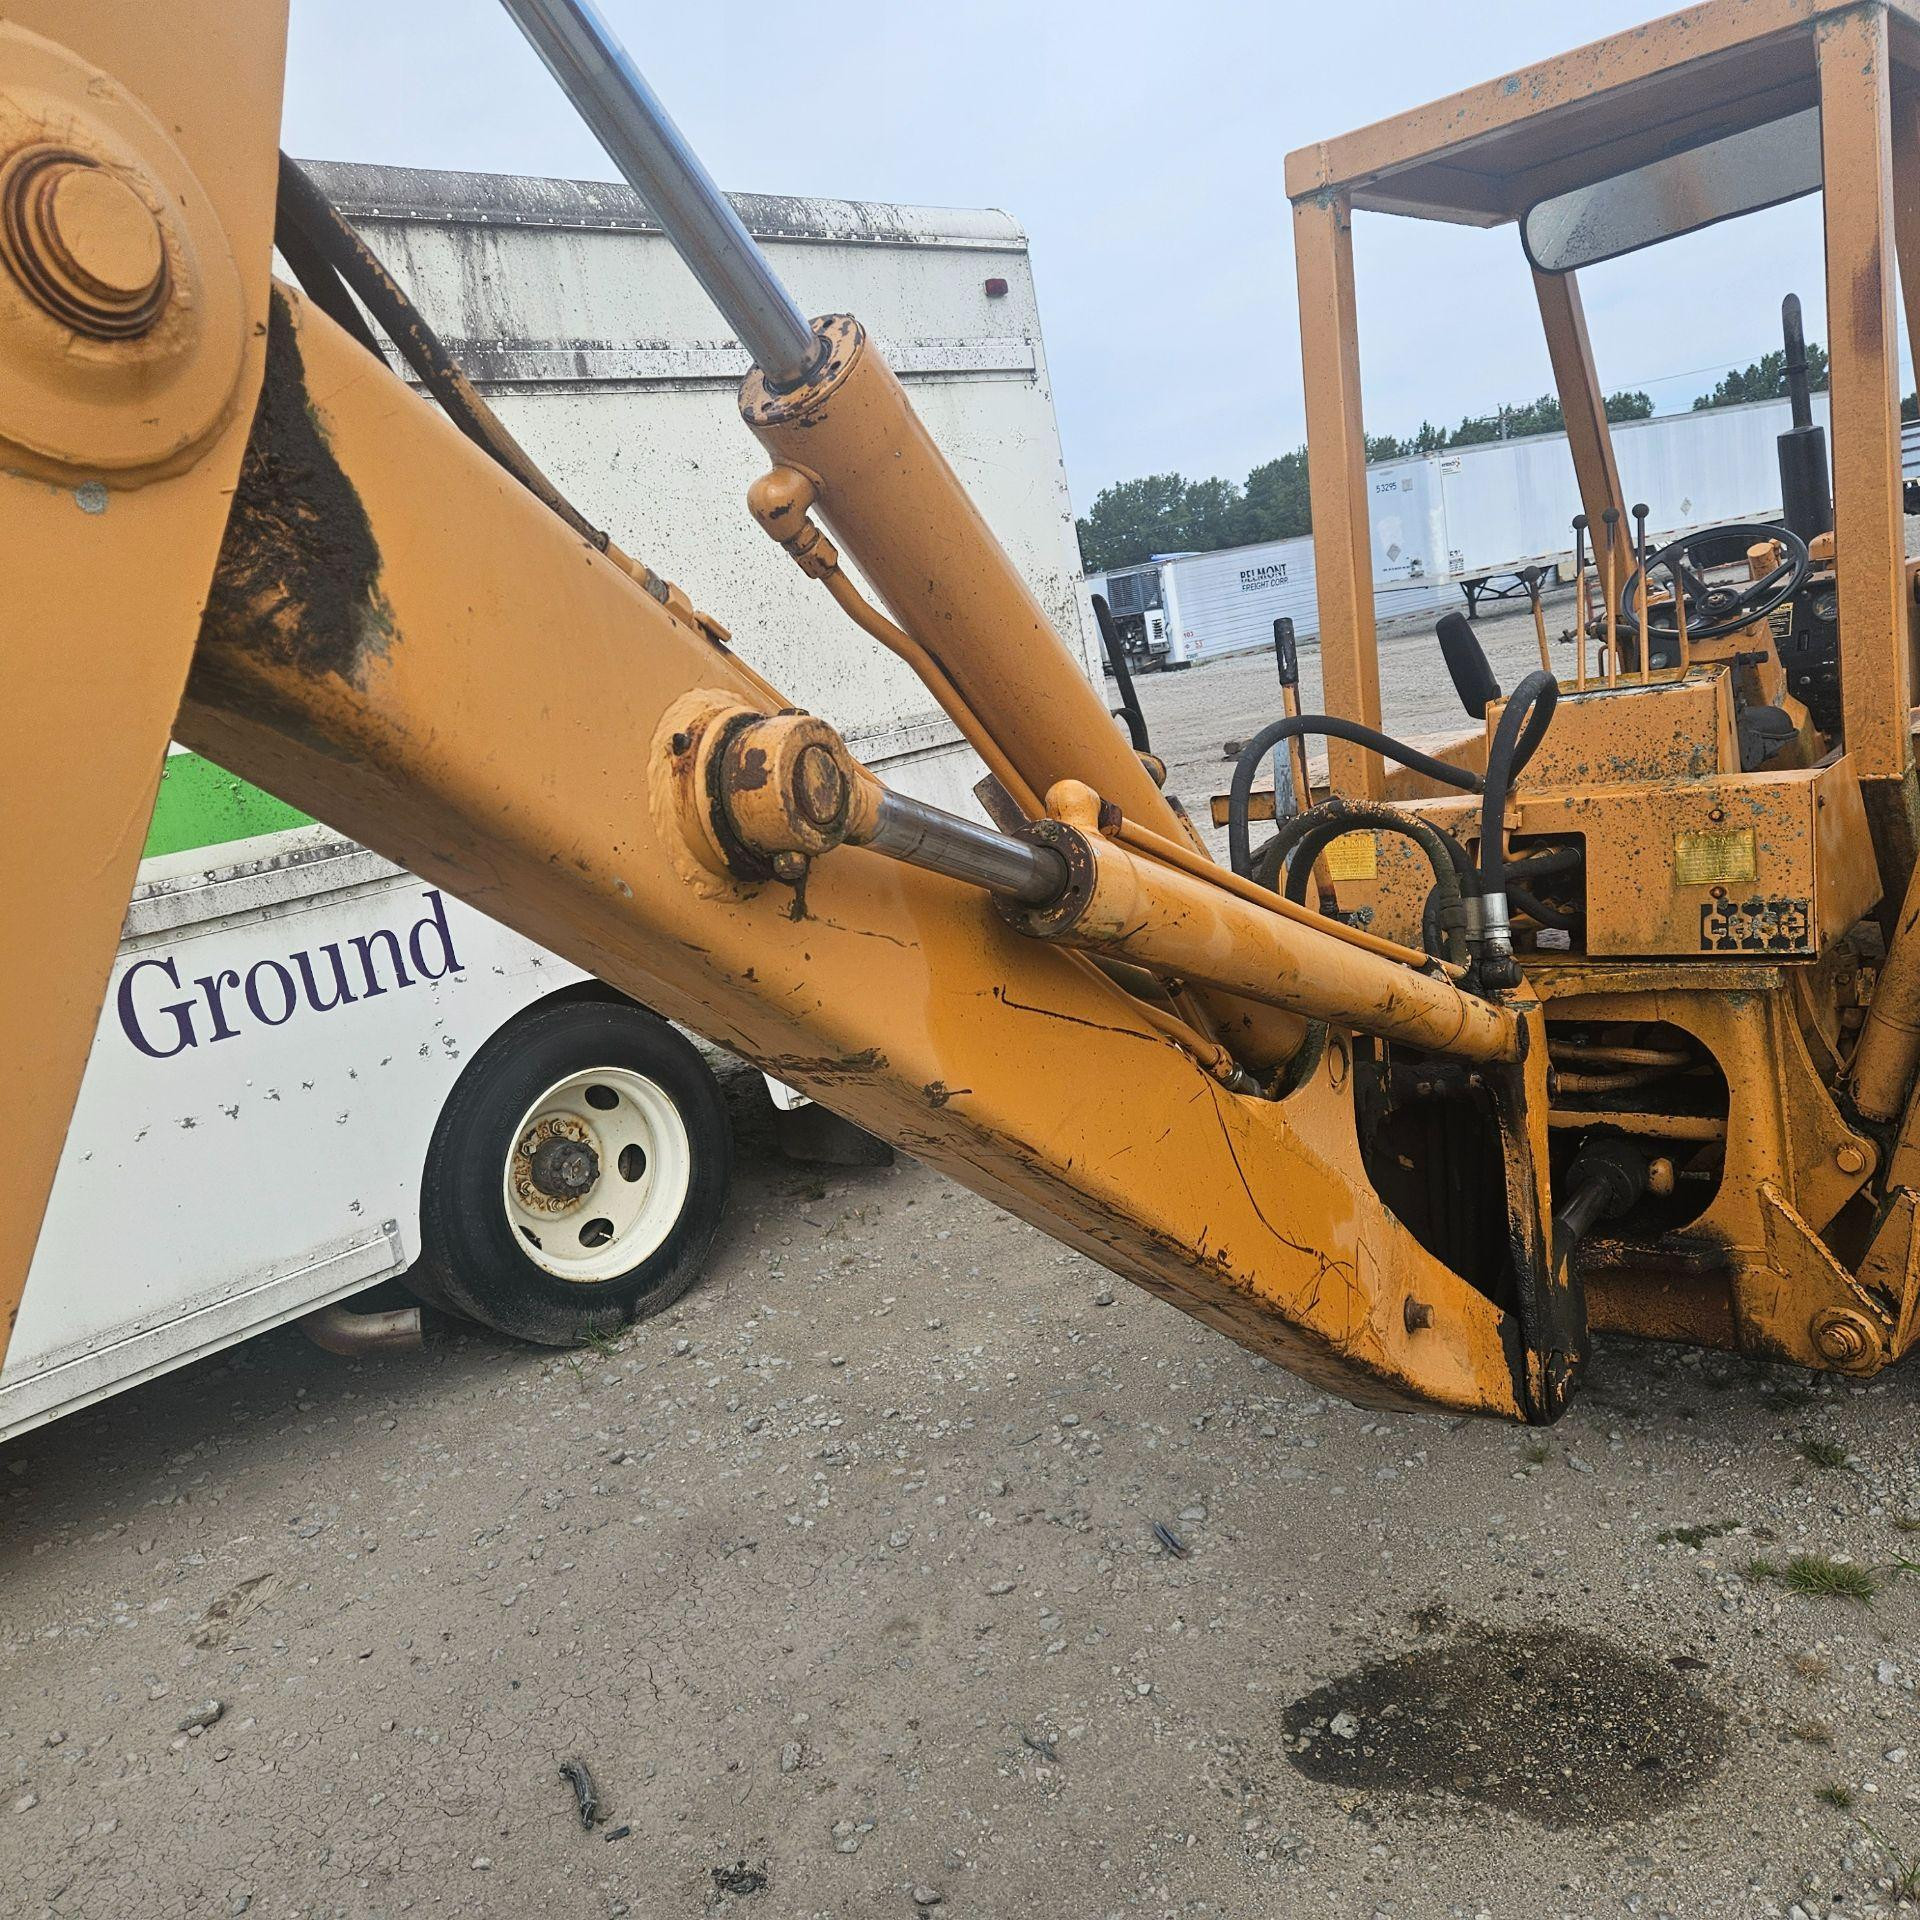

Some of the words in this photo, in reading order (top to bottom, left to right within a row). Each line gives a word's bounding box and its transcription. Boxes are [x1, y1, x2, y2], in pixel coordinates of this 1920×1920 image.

[1376, 482, 1397, 493] 53295
[1240, 563, 1286, 582] BELMONT
[1242, 580, 1269, 592] FREIGHT
[117, 889, 465, 1058] Ground
